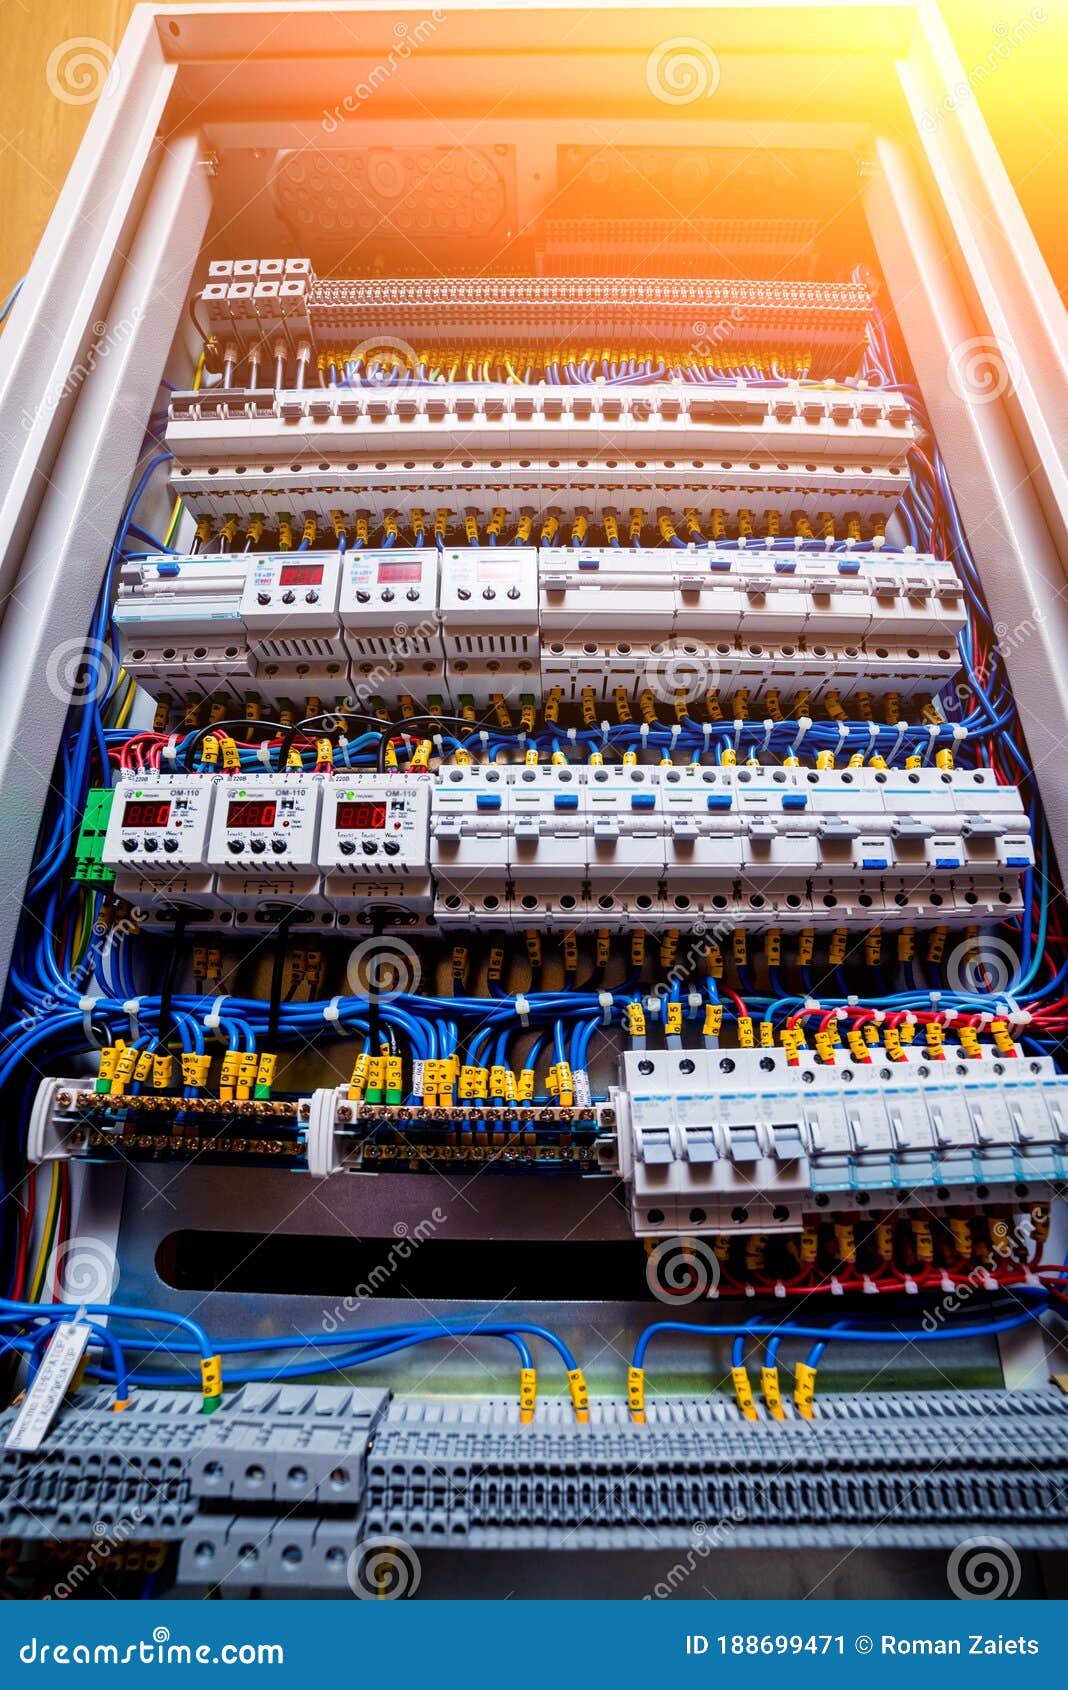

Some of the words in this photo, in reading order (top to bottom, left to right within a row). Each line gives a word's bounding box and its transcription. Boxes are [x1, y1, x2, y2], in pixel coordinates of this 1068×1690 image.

[631, 1004, 644, 1032] 055
[669, 1006, 681, 1033] 055
[711, 1008, 722, 1034] 055
[740, 1018, 752, 1044] 055
[154, 1060, 164, 1086] 024
[240, 1055, 254, 1085] 048
[259, 1056, 272, 1083] 023
[369, 1060, 379, 1087] 022
[389, 1060, 401, 1088] 035
[440, 1064, 451, 1091] 047
[465, 1069, 473, 1097] 045
[493, 1069, 503, 1095] 043
